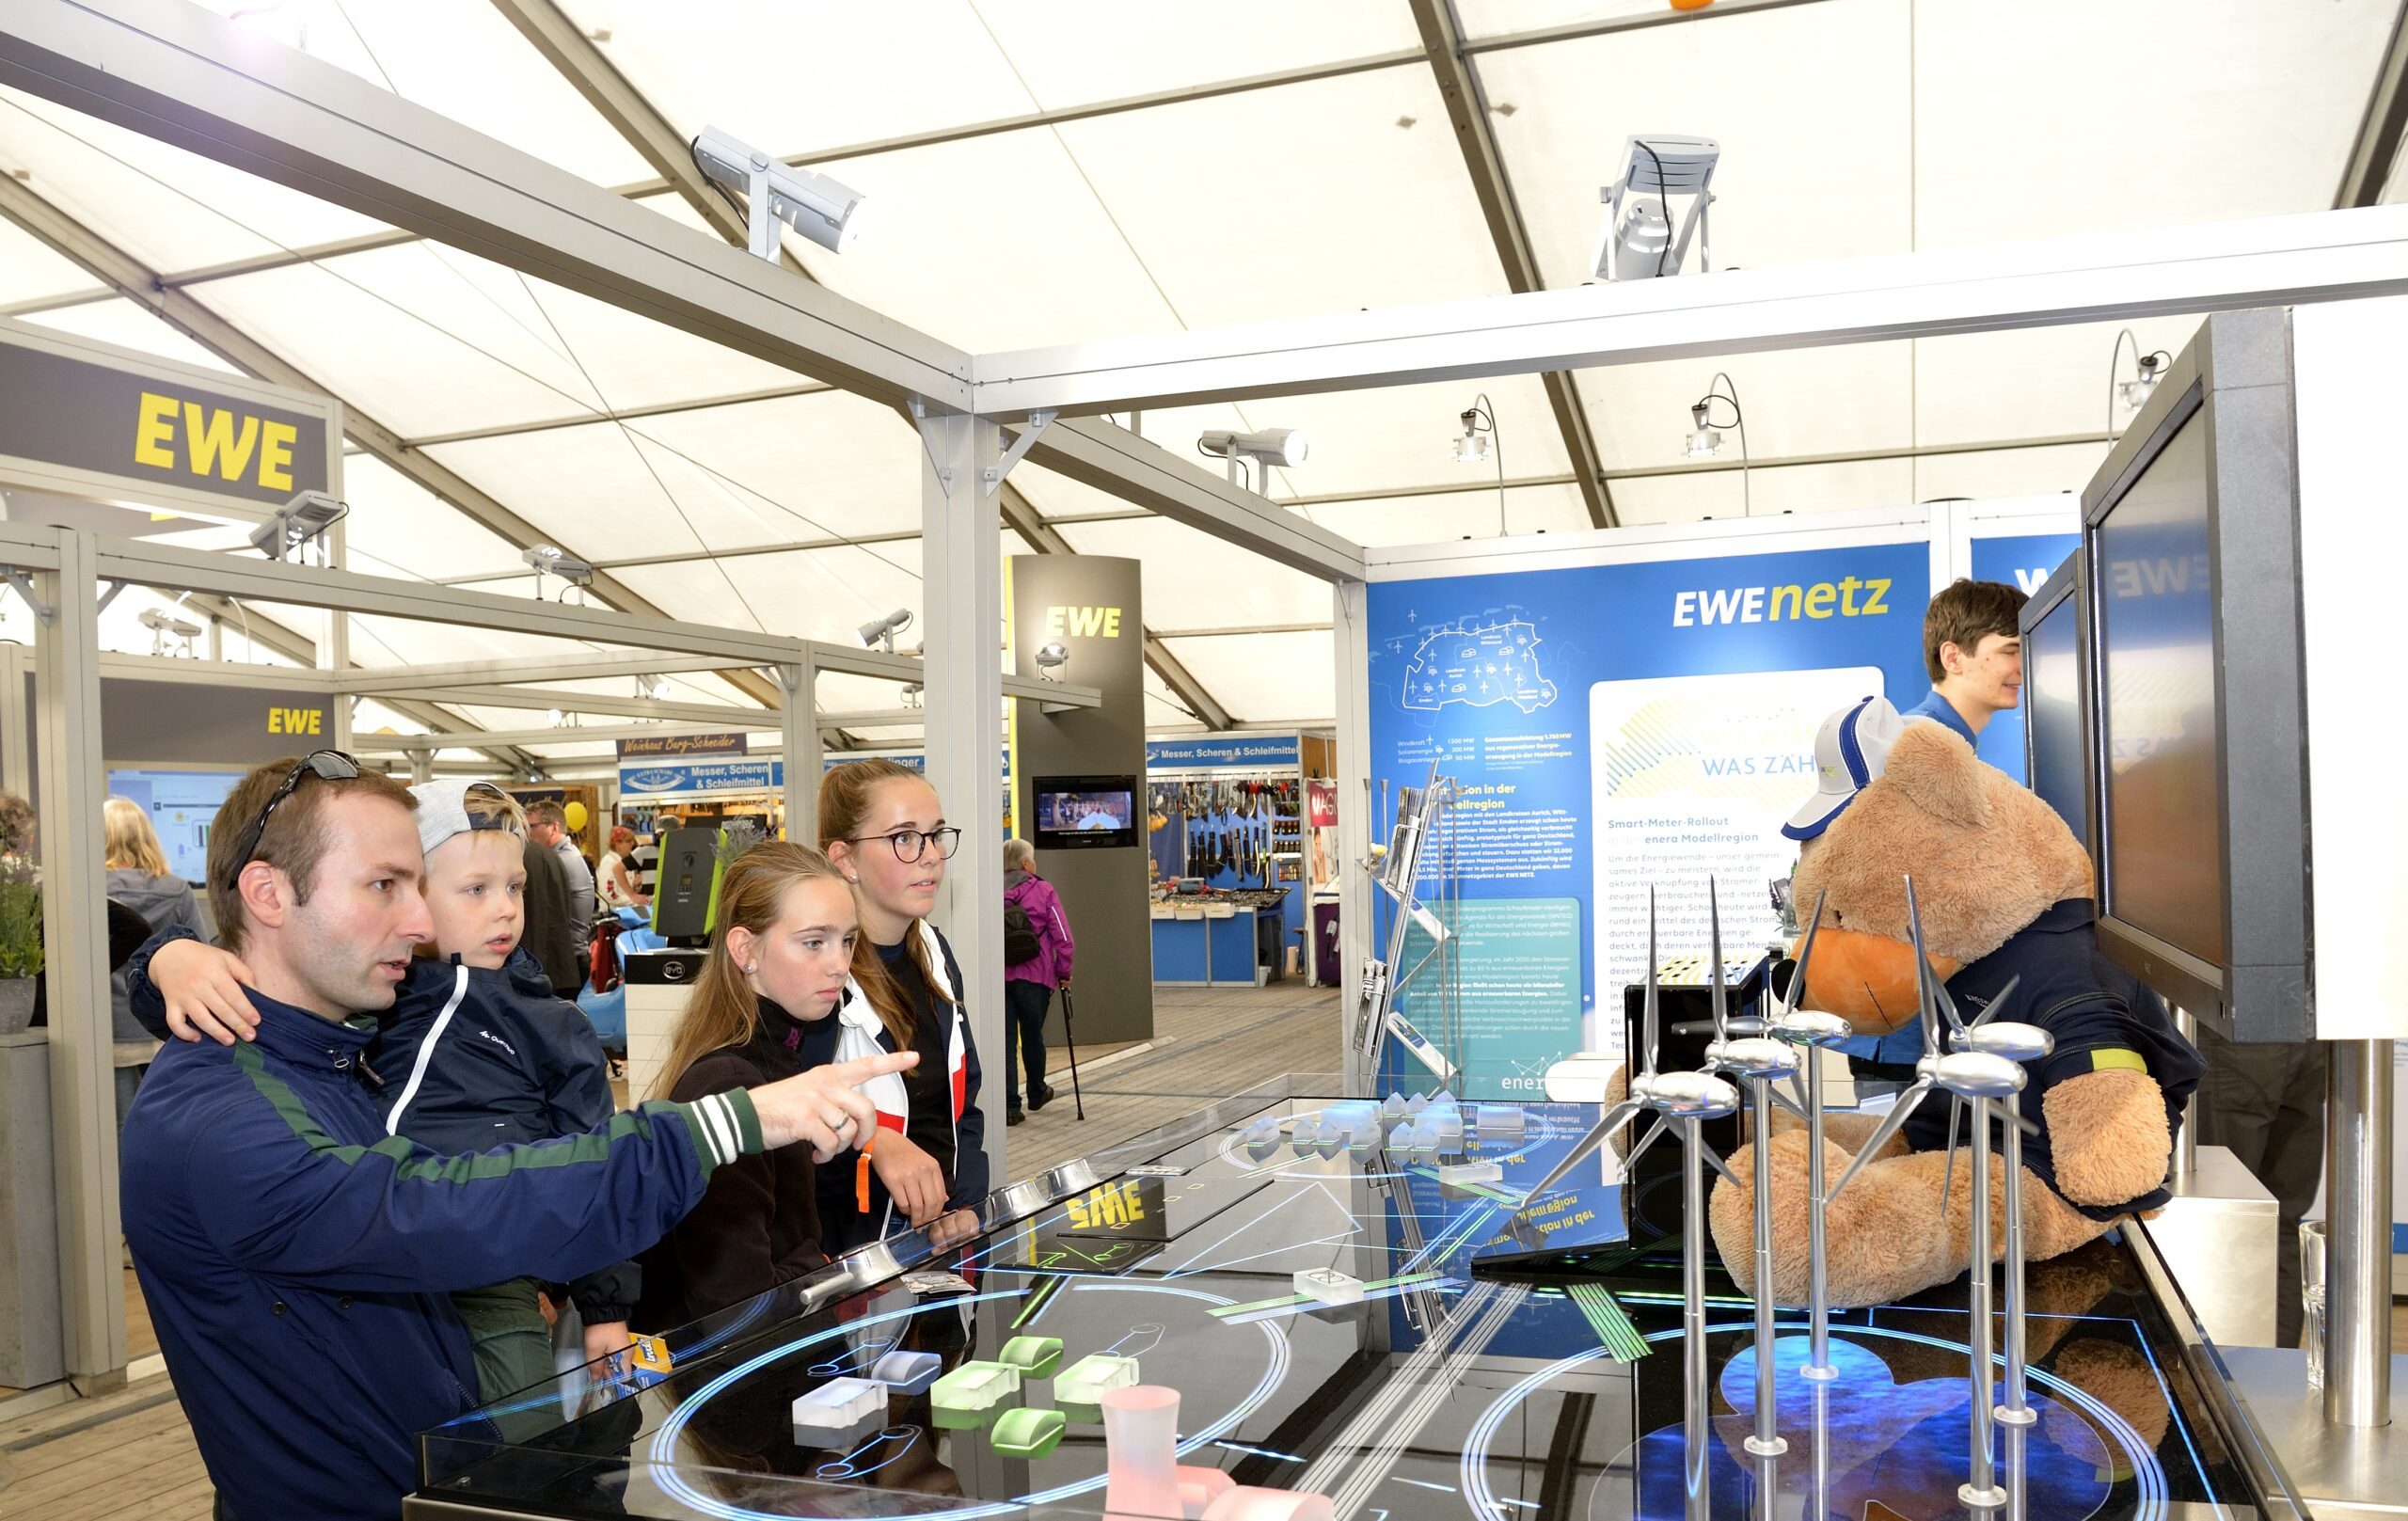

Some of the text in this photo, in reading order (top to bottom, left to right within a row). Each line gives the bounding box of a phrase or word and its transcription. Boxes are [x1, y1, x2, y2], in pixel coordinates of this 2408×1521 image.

[135, 391, 297, 492] EWE
[1044, 605, 1121, 639] EWE
[267, 707, 323, 735] EWE
[625, 738, 662, 753] Weinhaus
[1161, 750, 1195, 759] Messer,
[1196, 748, 1232, 757] Scheren
[1244, 746, 1299, 755] Schleifmittel
[691, 764, 768, 777] Messer, Scheren
[1703, 757, 1756, 776] WAS
[1765, 753, 1815, 774] ZÄH
[696, 776, 765, 789] & Schleifmittel
[1483, 783, 1494, 794] in
[1497, 783, 1516, 794] der
[1451, 799, 1505, 812] ellregion
[1608, 817, 1729, 829] Smart-Meter-Rollout
[1644, 835, 1678, 844] enera
[1681, 832, 1759, 845] Modellregion
[1625, 854, 1640, 863] die
[1642, 853, 1706, 863] Energiewende
[1640, 866, 1656, 875] Ziel
[1678, 865, 1721, 874] meistern,
[1608, 879, 1638, 888] aktive
[1717, 890, 1735, 898] und
[1718, 902, 1745, 911] heute
[1747, 902, 1767, 911] wird
[1653, 915, 1678, 924] rittel
[1680, 915, 1695, 924] des
[1698, 915, 1747, 924] deschen
[1750, 914, 1780, 924] Strom
[1609, 928, 1635, 938] durch
[1697, 928, 1737, 938] Enegien
[1609, 942, 1638, 950] deckt,
[1664, 941, 1690, 949] deren
[1501, 1075, 1545, 1090] ener
